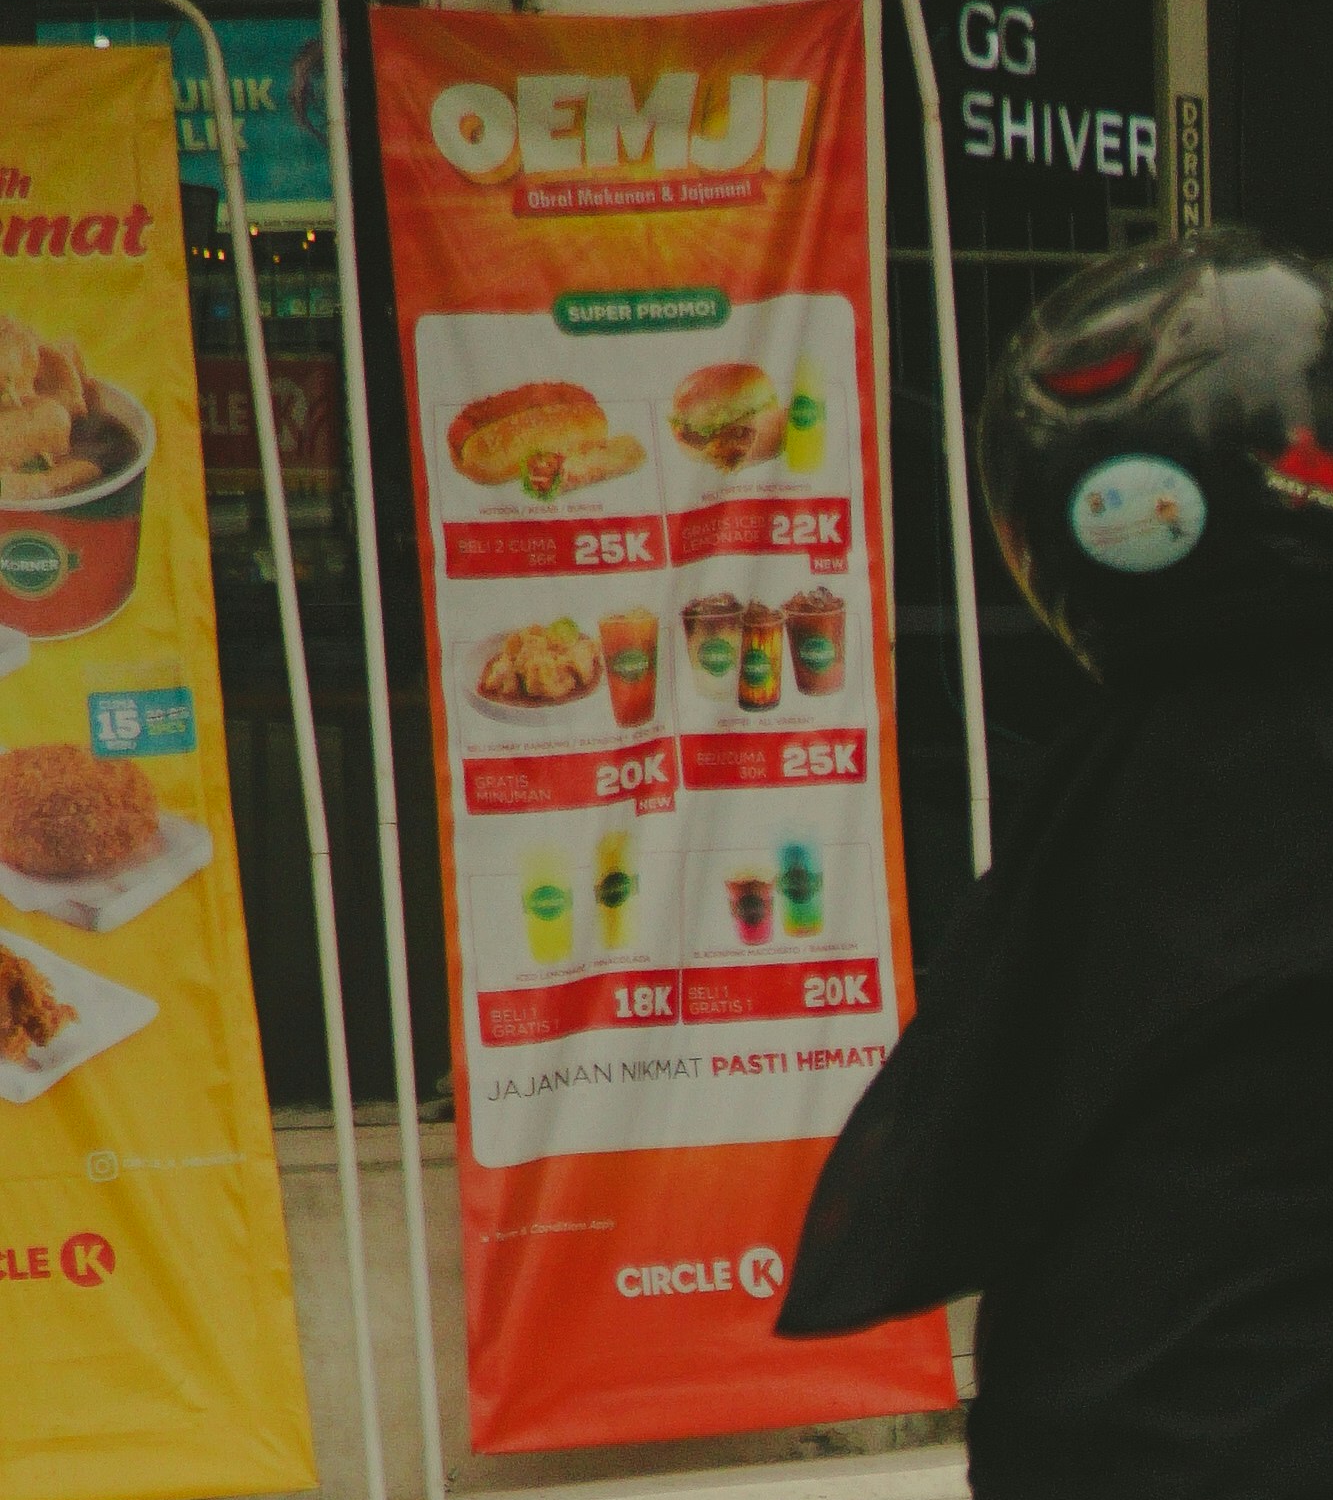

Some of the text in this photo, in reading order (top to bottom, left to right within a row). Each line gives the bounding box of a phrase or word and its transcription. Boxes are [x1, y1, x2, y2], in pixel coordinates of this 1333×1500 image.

[958, 0, 1037, 75] GG
[431, 73, 815, 175] OEMJI
[962, 90, 1157, 178] SHIVER
[0, 202, 153, 258] mat
[568, 301, 631, 323] SUPER
[573, 531, 654, 565] 25K
[771, 513, 842, 545] 22K
[595, 751, 669, 797] 20K
[783, 743, 858, 778] 25K
[613, 986, 673, 1019] 18K
[803, 974, 871, 1008] 20K
[487, 1062, 612, 1102] JAJANAN
[620, 1056, 704, 1084] NIKMAT
[711, 1053, 788, 1079] PASTI
[65, 1235, 115, 1287] K
[617, 1249, 783, 1299] CIRCLE K
